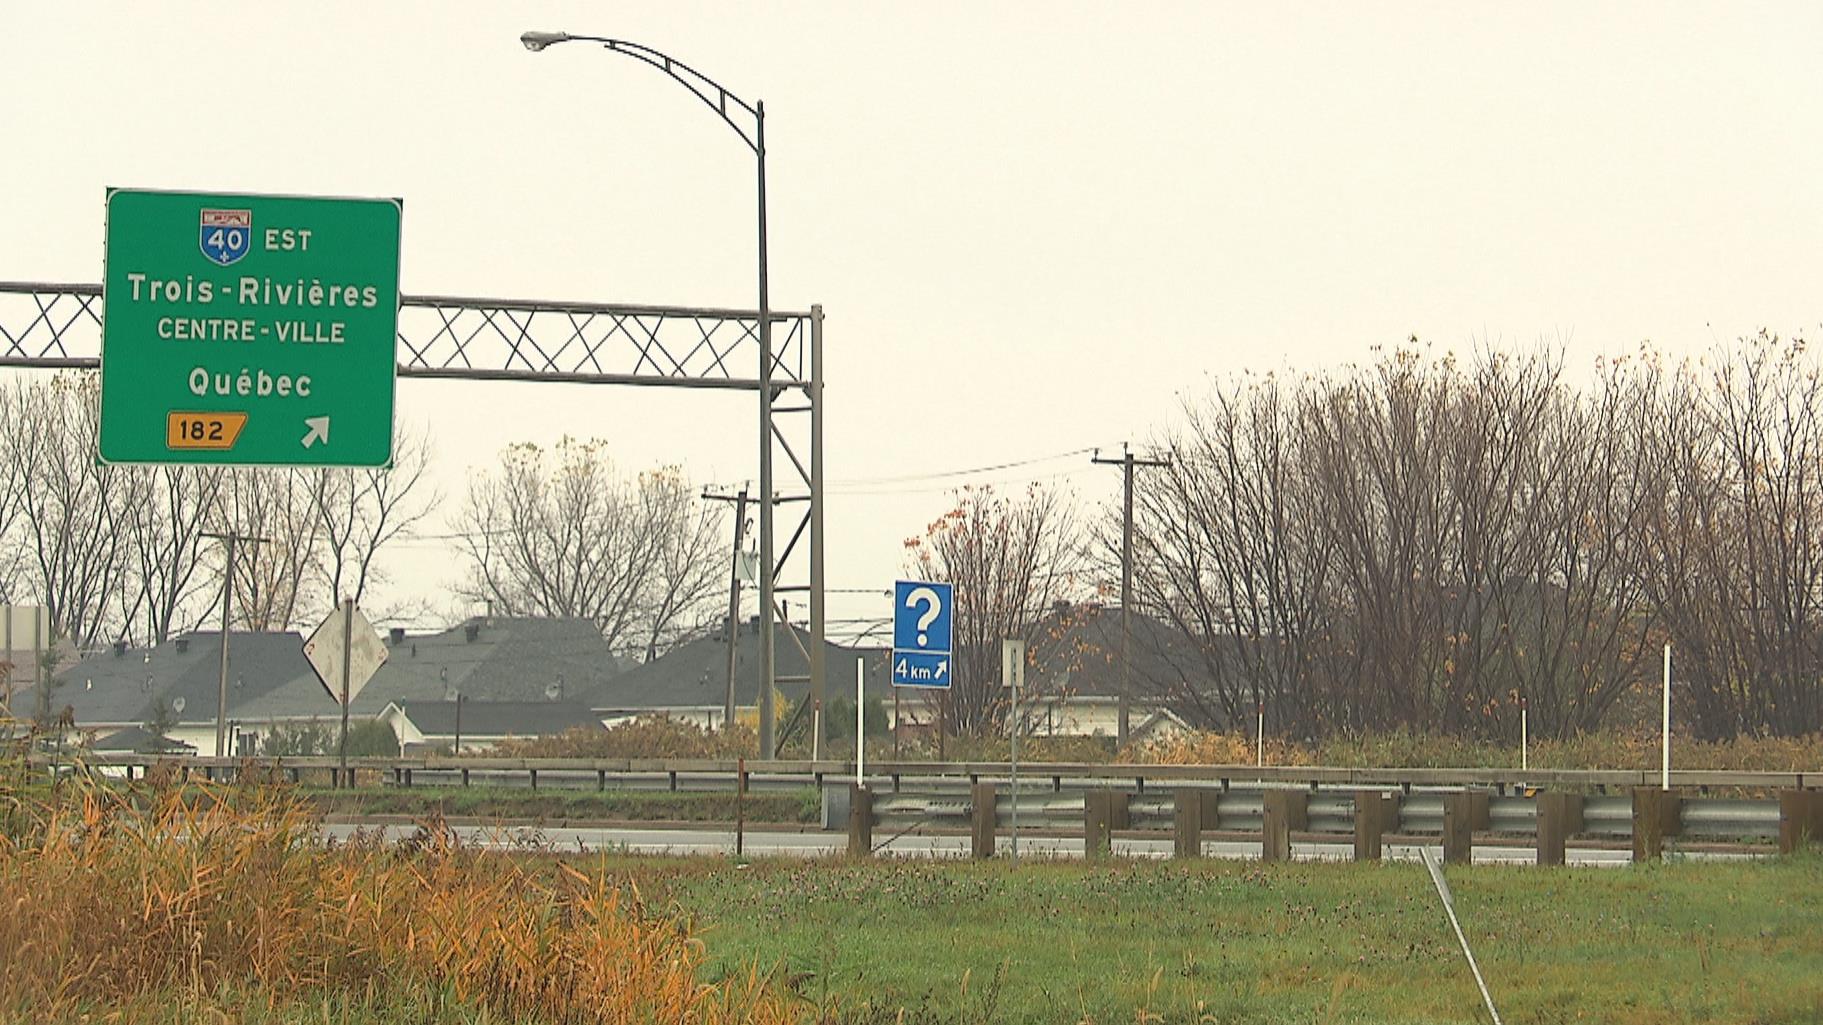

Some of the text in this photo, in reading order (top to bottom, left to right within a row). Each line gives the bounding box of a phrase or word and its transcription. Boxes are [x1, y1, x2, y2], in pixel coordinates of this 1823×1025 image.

[207, 229, 312, 251] 40 EST
[127, 273, 378, 308] Trois-Rivières
[157, 317, 346, 343] CENTRE-VILLE
[188, 366, 312, 397] Québec
[180, 420, 223, 441] 182
[905, 587, 942, 647] ?
[895, 658, 931, 680] 4 km
